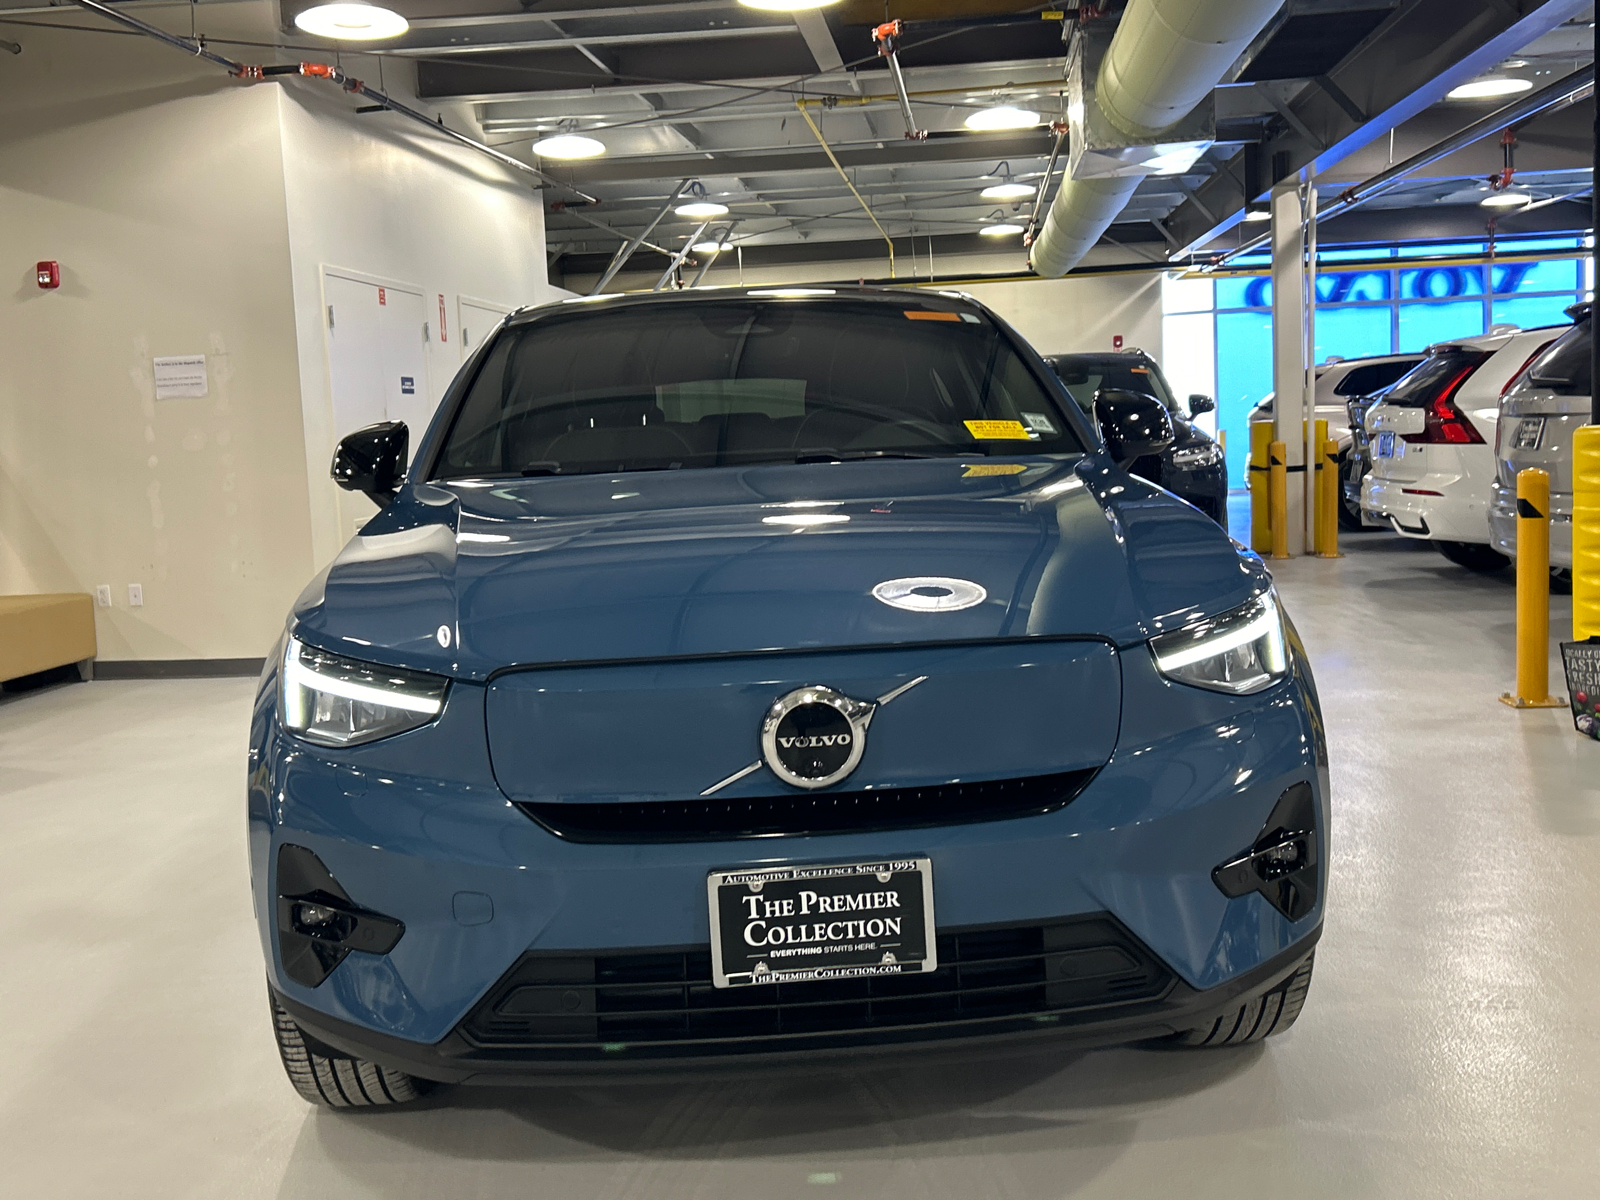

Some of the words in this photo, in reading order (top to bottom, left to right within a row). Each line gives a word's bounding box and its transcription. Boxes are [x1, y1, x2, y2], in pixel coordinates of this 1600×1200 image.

[778, 733, 851, 748] VOLVO
[725, 871, 789, 884] AUTOMOTIVE
[792, 866, 853, 879] EXCELLENCE
[856, 863, 885, 874] SINCE
[888, 862, 916, 872] 1995
[742, 894, 795, 919] THE
[798, 891, 901, 915] PREMIER
[743, 917, 901, 947] COLLECTION
[770, 947, 822, 958] EVERYTHING
[824, 945, 853, 954] STARTS
[855, 943, 877, 951] HERE.
